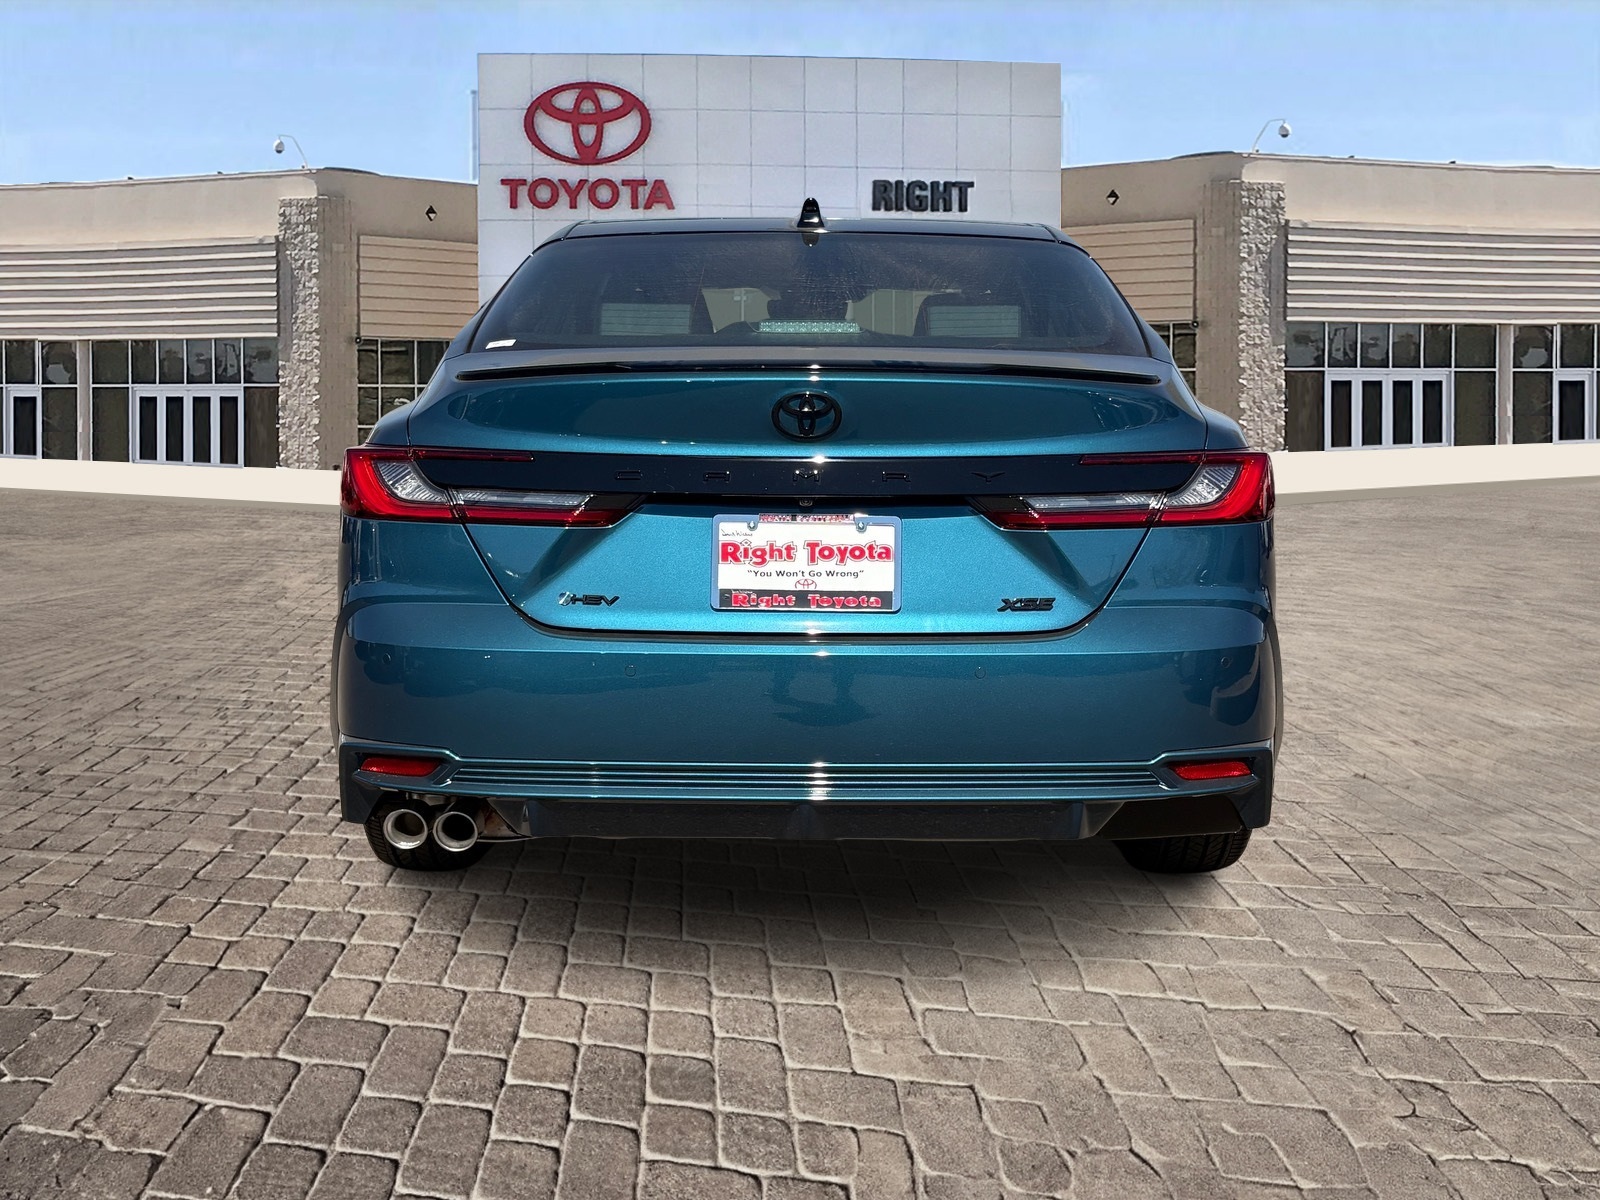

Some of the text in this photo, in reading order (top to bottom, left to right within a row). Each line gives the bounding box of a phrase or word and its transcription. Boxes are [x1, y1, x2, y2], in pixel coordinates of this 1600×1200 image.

[500, 177, 676, 210] TOYOTA
[872, 179, 975, 212] RIGHT
[615, 469, 1006, 483] CAMRY
[719, 540, 893, 567] Right Toyota
[775, 569, 806, 578] Won't
[808, 569, 823, 578] Go
[731, 592, 882, 609] Right Toyota
[997, 597, 1056, 612] XSE
